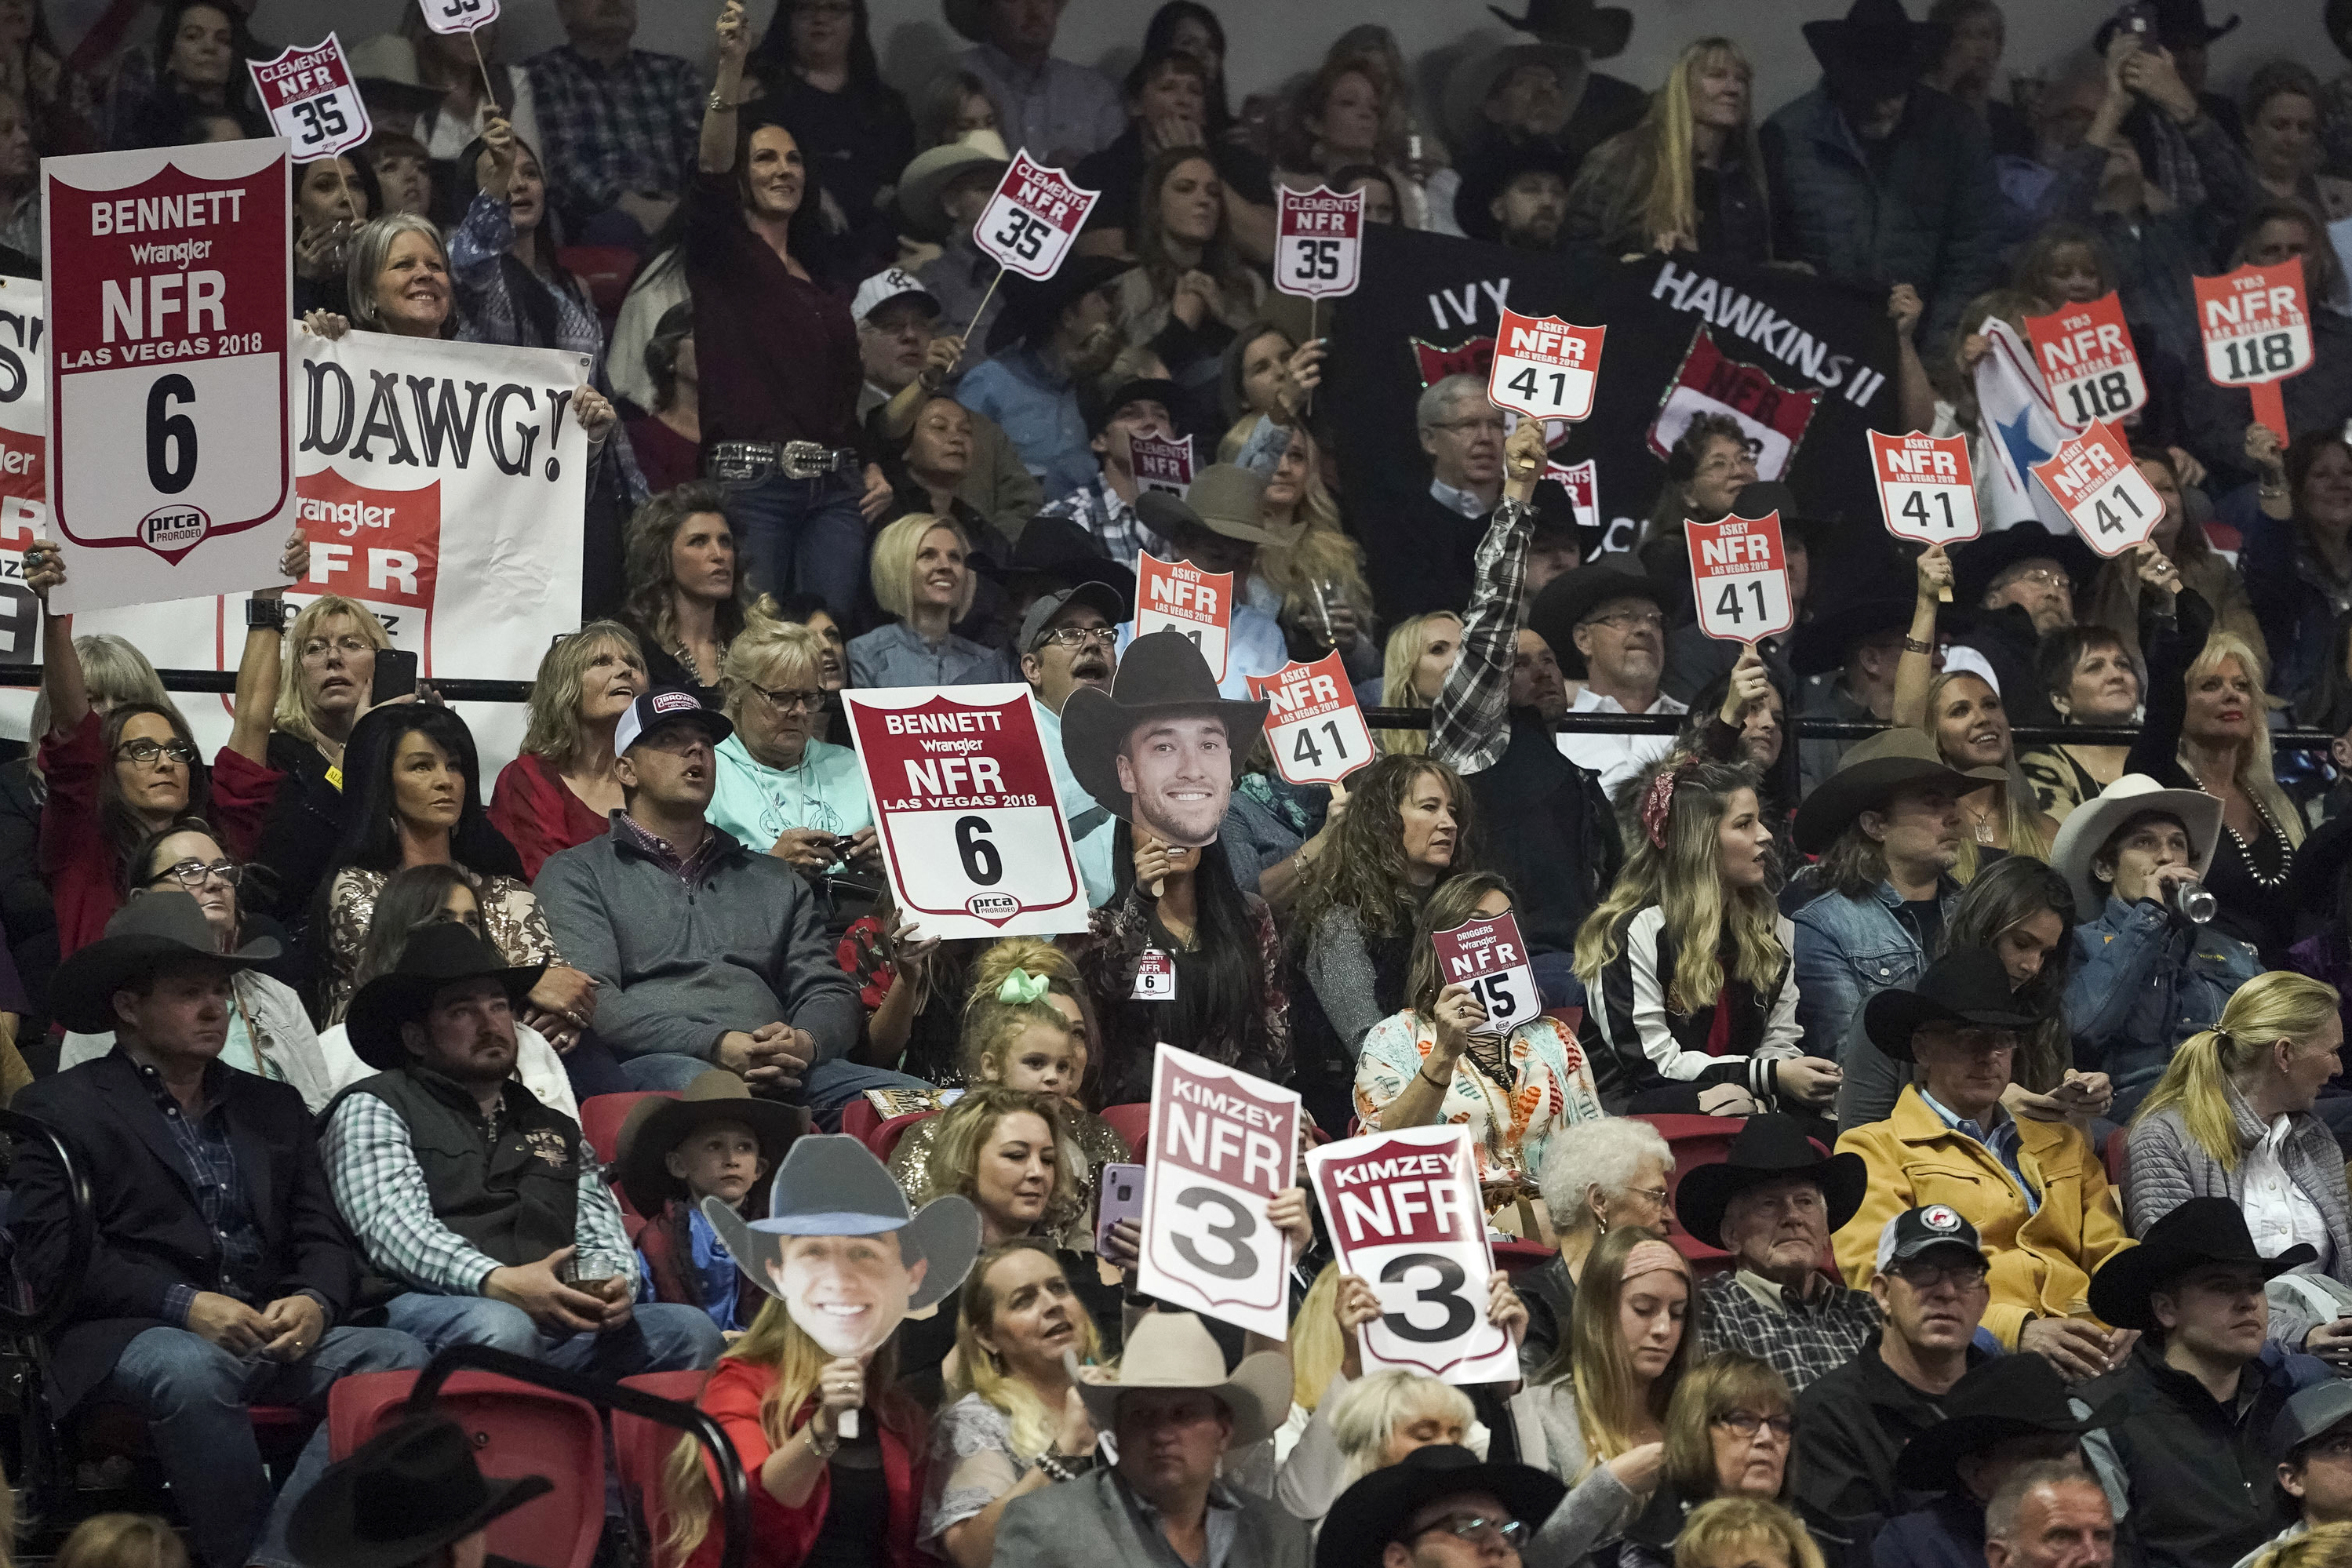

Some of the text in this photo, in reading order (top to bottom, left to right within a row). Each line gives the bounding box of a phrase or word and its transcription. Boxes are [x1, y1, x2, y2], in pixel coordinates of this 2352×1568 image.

[260, 46, 337, 82] CLEMENTS
[277, 66, 333, 98] NFR
[292, 93, 348, 145] 35
[1016, 163, 1088, 211] CLEMENTS
[1017, 180, 1069, 221] NFR
[1286, 197, 1359, 213] CLEMENTS
[92, 189, 246, 235] BENNETT
[1296, 212, 1345, 231] NFR
[995, 207, 1051, 261] 35
[130, 238, 213, 270] Wrangler
[1296, 240, 1341, 280] 35
[102, 270, 227, 343] NFR
[2206, 285, 2299, 328] NFR
[1429, 261, 1886, 408] IVY HAWKINS II
[1510, 327, 1586, 361] NFR
[1535, 321, 1570, 335] ASKEY
[61, 332, 263, 369] LAS VEGAS 2018
[1515, 349, 1579, 369] LAS VEGAS 2018
[2042, 323, 2126, 372] NFR
[2225, 333, 2294, 380] 118
[1508, 367, 1566, 406] 41
[2068, 370, 2132, 423] 118
[146, 373, 198, 494] 6
[300, 358, 573, 482] DAWG!
[1904, 438, 1935, 449] ASKEY
[2059, 440, 2084, 464] ASKEY
[1885, 449, 1957, 475] NFR
[1895, 473, 1957, 484] LAS VEGAS 2018
[2052, 442, 2115, 497] NFR
[2073, 490, 2088, 503] LAS
[2087, 476, 2105, 494] VEGAS
[296, 492, 395, 537] rangler
[1902, 491, 1954, 528] 41
[2095, 484, 2144, 535] 41
[148, 513, 200, 543] prca
[157, 529, 201, 542] PRORODEO
[1719, 522, 1749, 537] ASKEY
[1701, 534, 1771, 566] NFR
[1710, 561, 1769, 575] LAS VEGAS 2018
[1172, 566, 1201, 584] ASKEY
[1150, 574, 1218, 614] NFR
[1717, 580, 1767, 624] 41
[1155, 602, 1213, 624] LAS VEGAS 2018
[1280, 666, 1311, 685] ASKEY
[1268, 675, 1339, 715] NFR
[1280, 700, 1339, 724] LAS VEGAS 2018
[885, 711, 1002, 735] BENNETT
[919, 737, 983, 756] Wrangler
[1294, 720, 1348, 767] 41
[904, 757, 1007, 796] NFR
[883, 794, 1037, 810] LAS VEGAS 2018
[955, 815, 1003, 886] 6
[972, 897, 1013, 914] prca
[981, 906, 1016, 915] PRORODEO
[1456, 925, 1494, 941] DRIGGERS
[1458, 935, 1497, 951] Wrangler
[1451, 943, 1517, 977] NFR
[1473, 968, 1494, 977] VEGAS
[1145, 975, 1155, 988] 6
[1470, 973, 1516, 1021] 15
[1172, 1077, 1283, 1133] KIMZEY
[1166, 1103, 1283, 1192] NFR
[1333, 1153, 1458, 1188] KIMZEY
[1338, 1179, 1464, 1241] NFR
[1171, 1187, 1258, 1279] 3
[1379, 1253, 1475, 1343] 3
